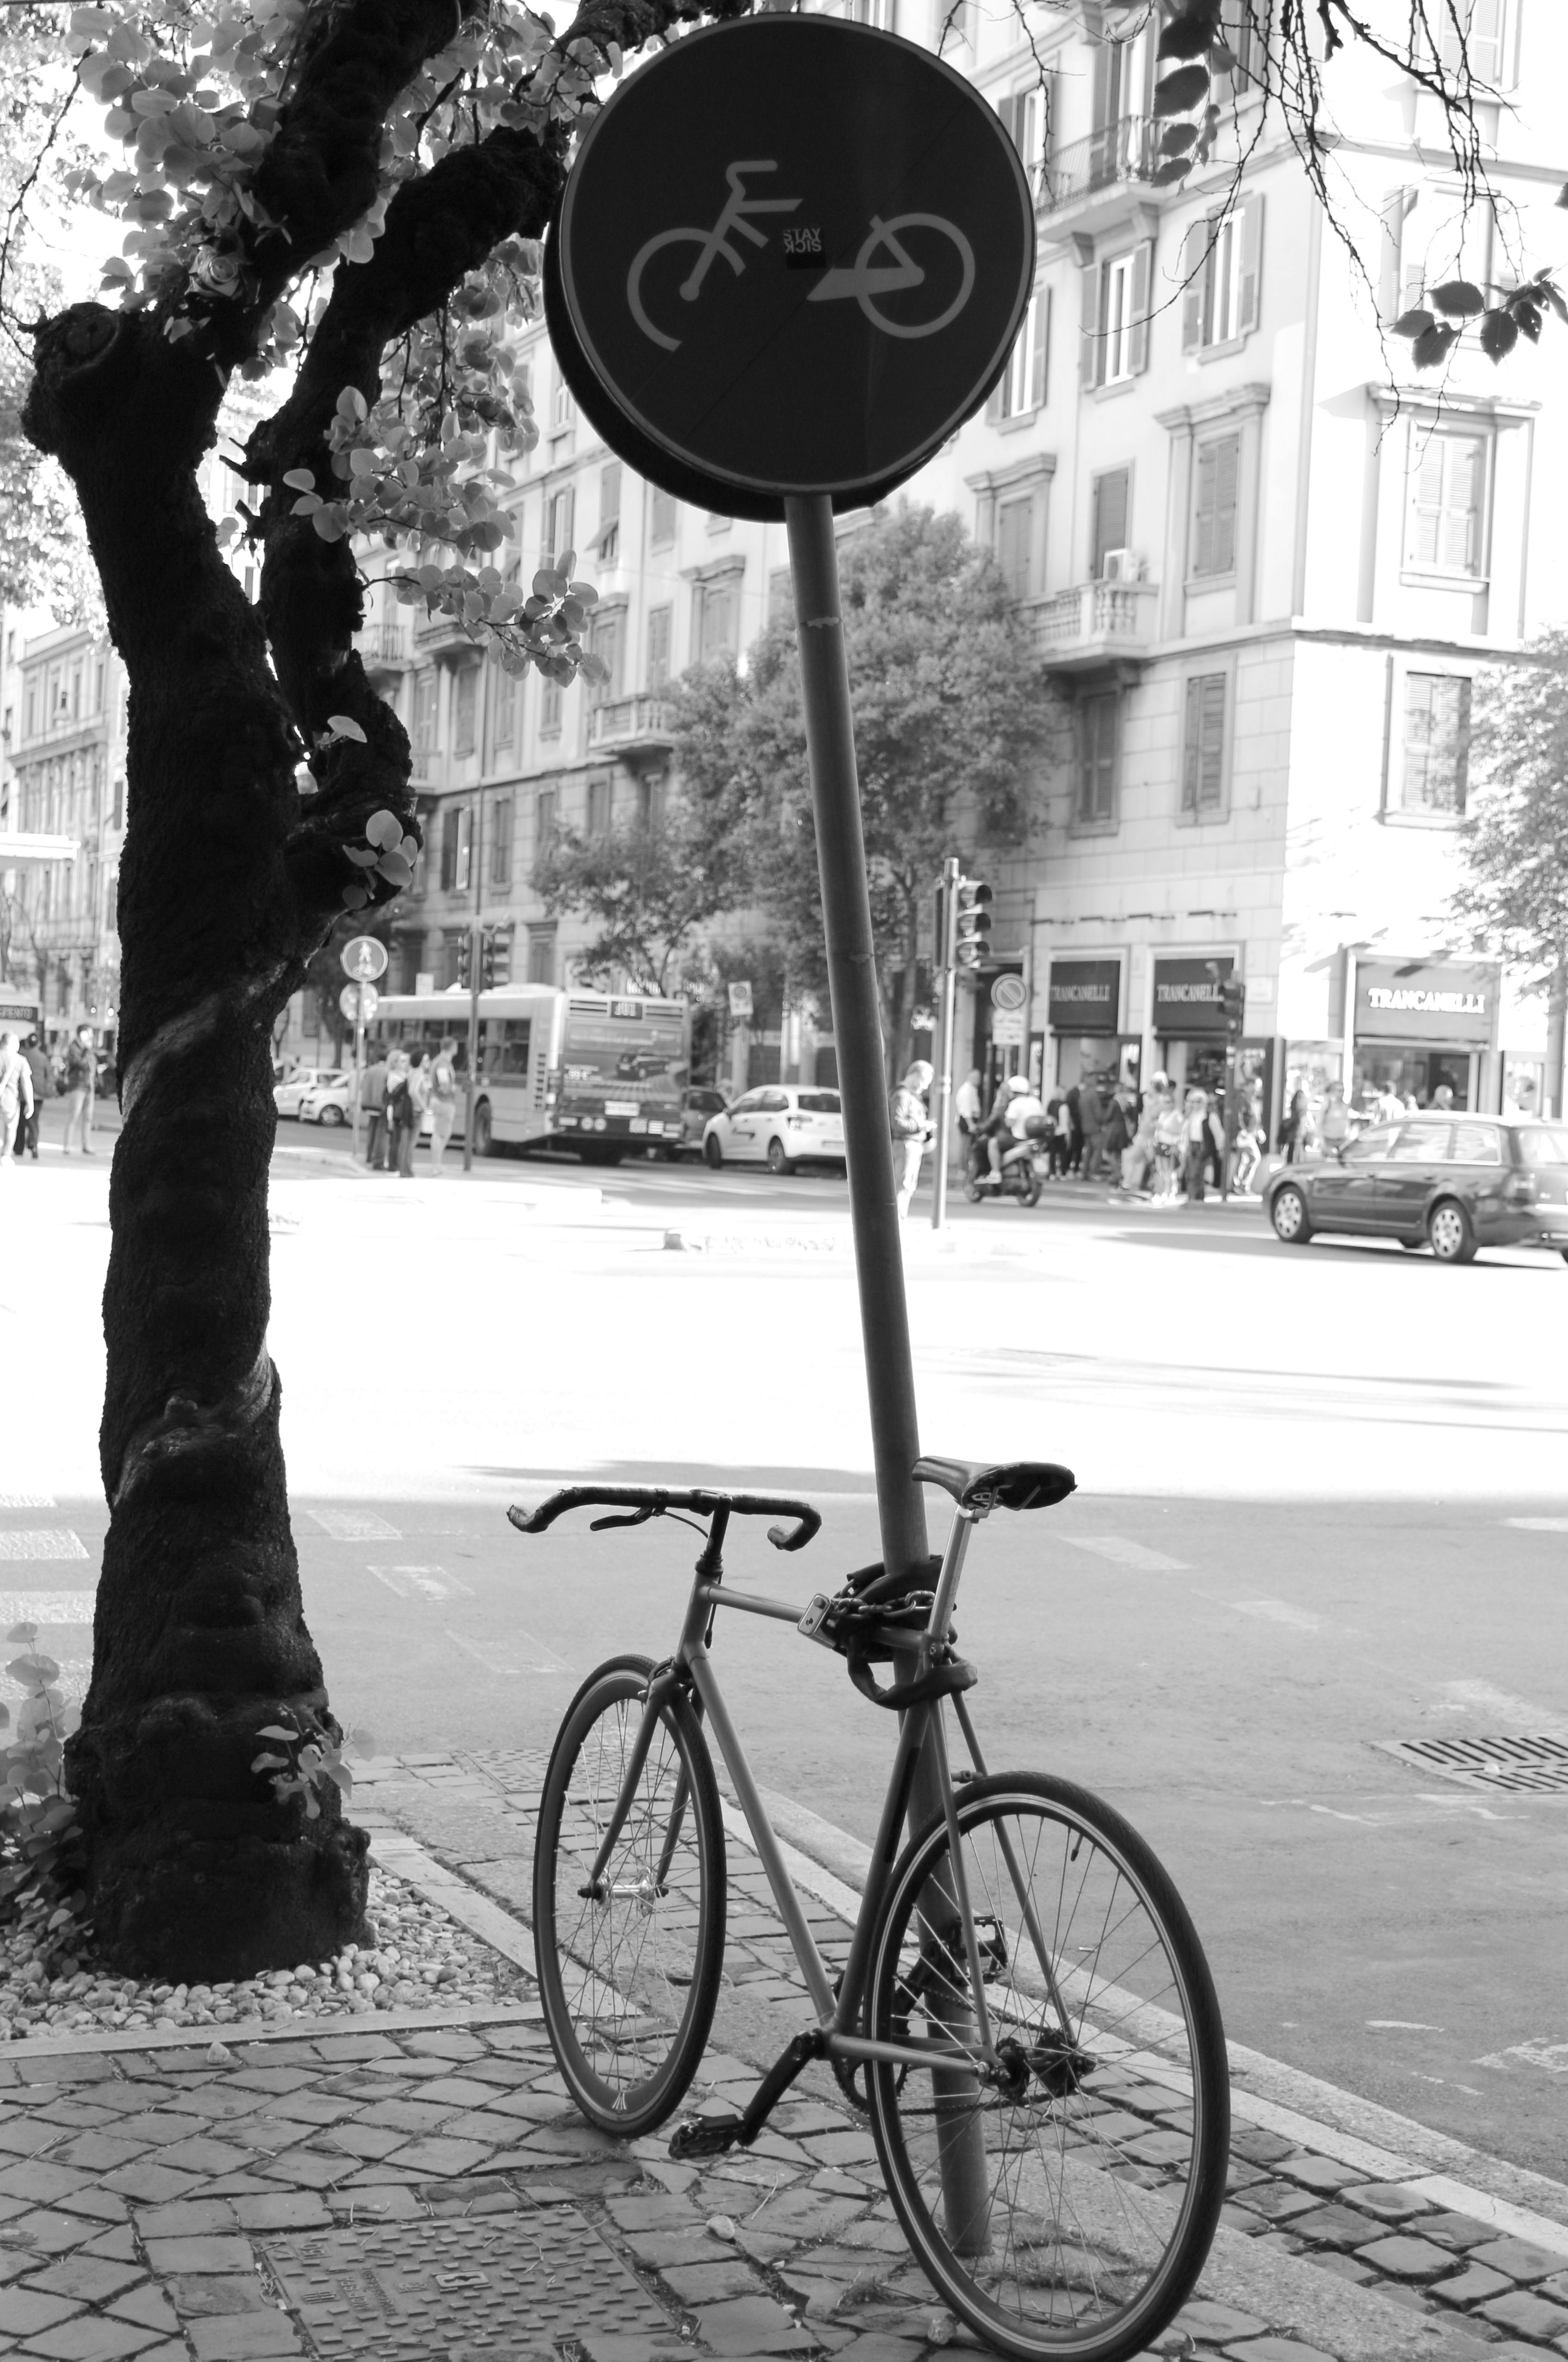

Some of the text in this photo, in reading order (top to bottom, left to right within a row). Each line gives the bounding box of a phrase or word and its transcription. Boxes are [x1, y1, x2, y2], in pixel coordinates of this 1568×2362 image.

[783, 227, 821, 241] STAY
[1051, 984, 1110, 1002] TRANCANELLI
[1368, 988, 1486, 1014] TRANCANELLI
